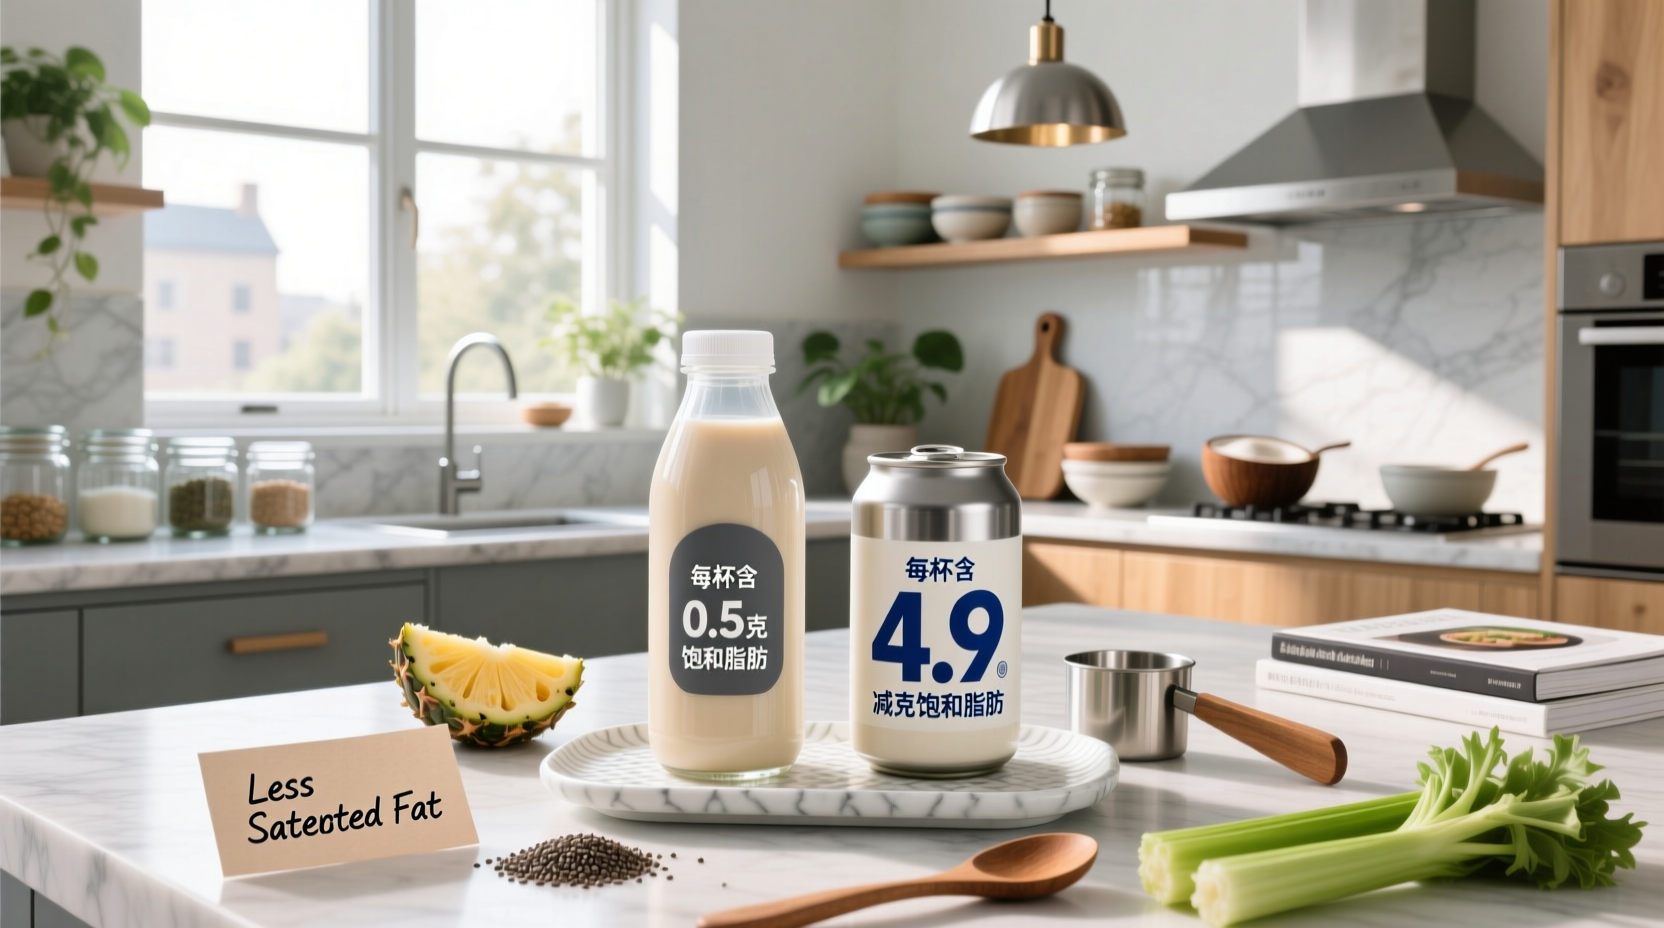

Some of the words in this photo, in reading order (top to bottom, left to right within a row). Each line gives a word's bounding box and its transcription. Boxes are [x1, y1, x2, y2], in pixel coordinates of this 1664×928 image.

[690, 564, 758, 590] 每杯含
[905, 556, 976, 583] 每杯含
[681, 599, 768, 640] 0.5克
[871, 589, 1004, 684] 4.9
[681, 645, 769, 671] 饱和脂肪
[872, 689, 1005, 719] 减克饱和脂肪
[248, 772, 315, 806] Less
[392, 789, 443, 825] Fat
